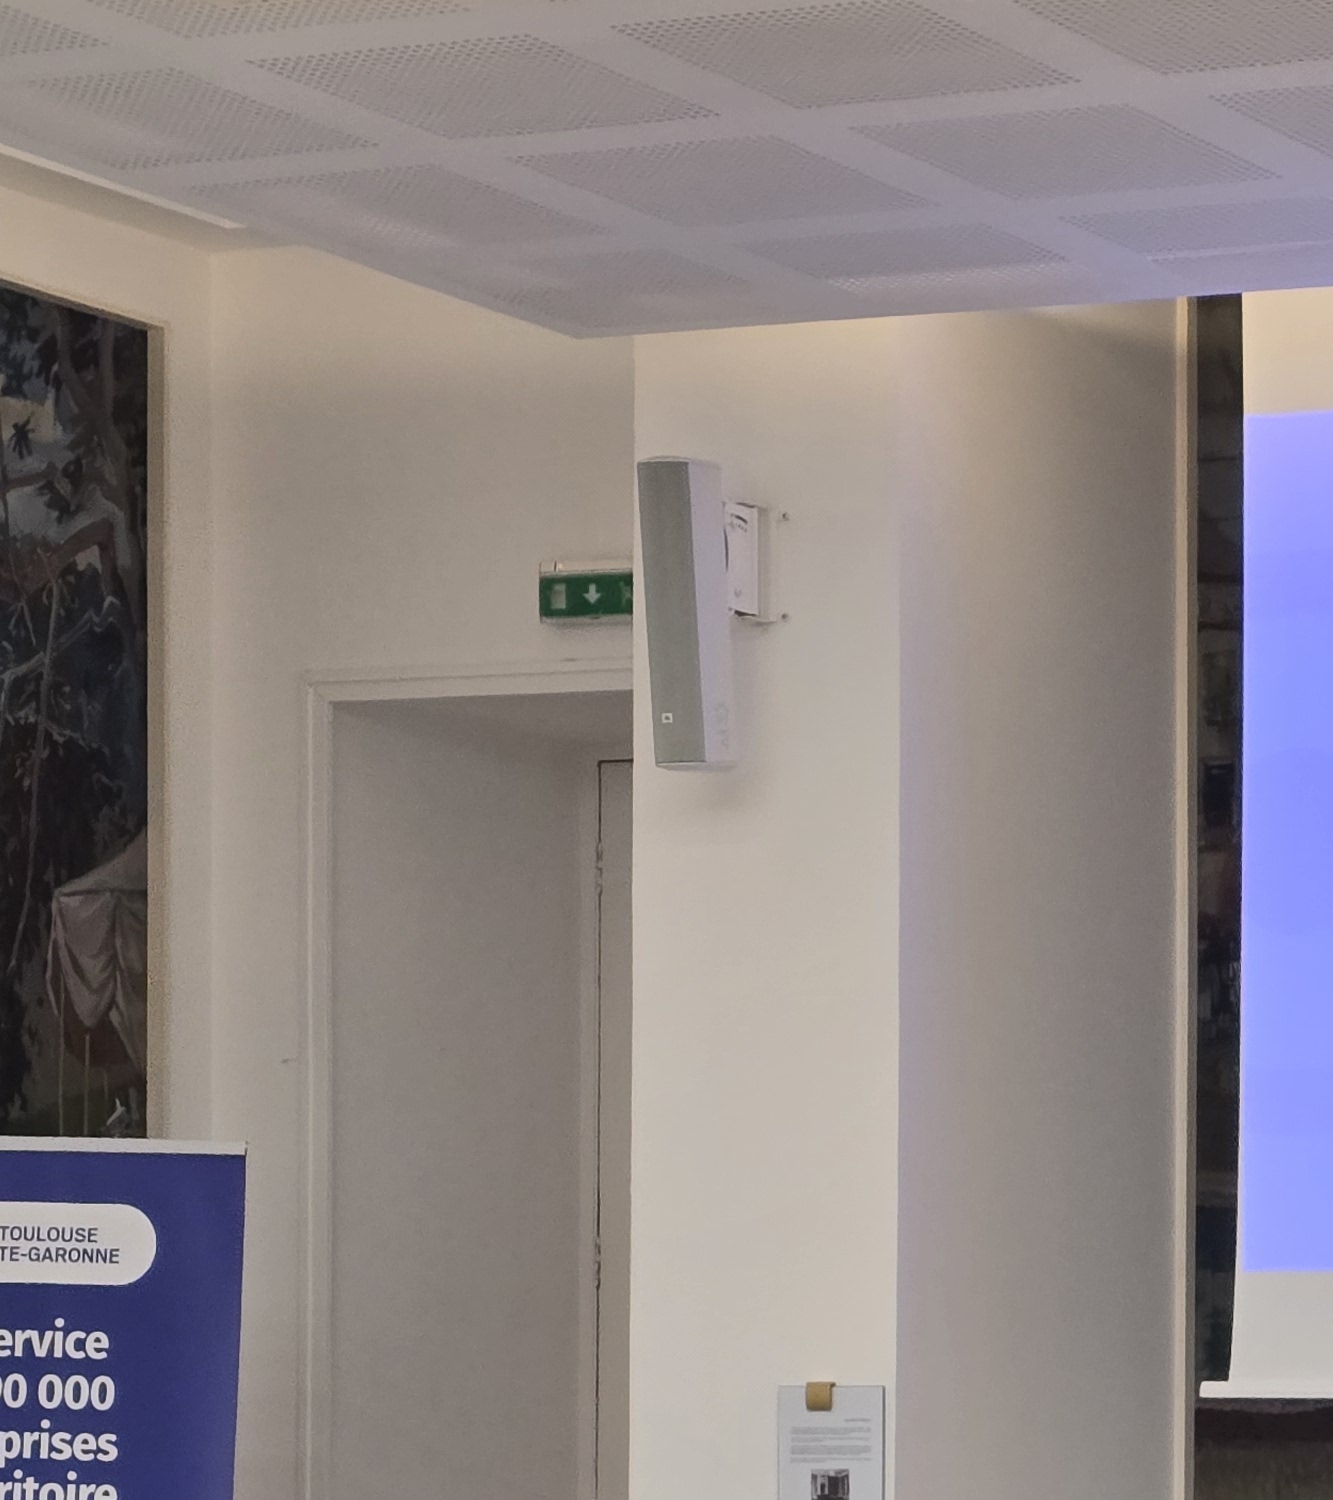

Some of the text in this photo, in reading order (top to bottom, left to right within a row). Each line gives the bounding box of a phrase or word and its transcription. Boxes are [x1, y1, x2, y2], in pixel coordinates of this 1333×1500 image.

[0, 1225, 99, 1244] TOULOUSE
[0, 1373, 115, 1411] 0 000
[0, 1418, 119, 1469] prises
